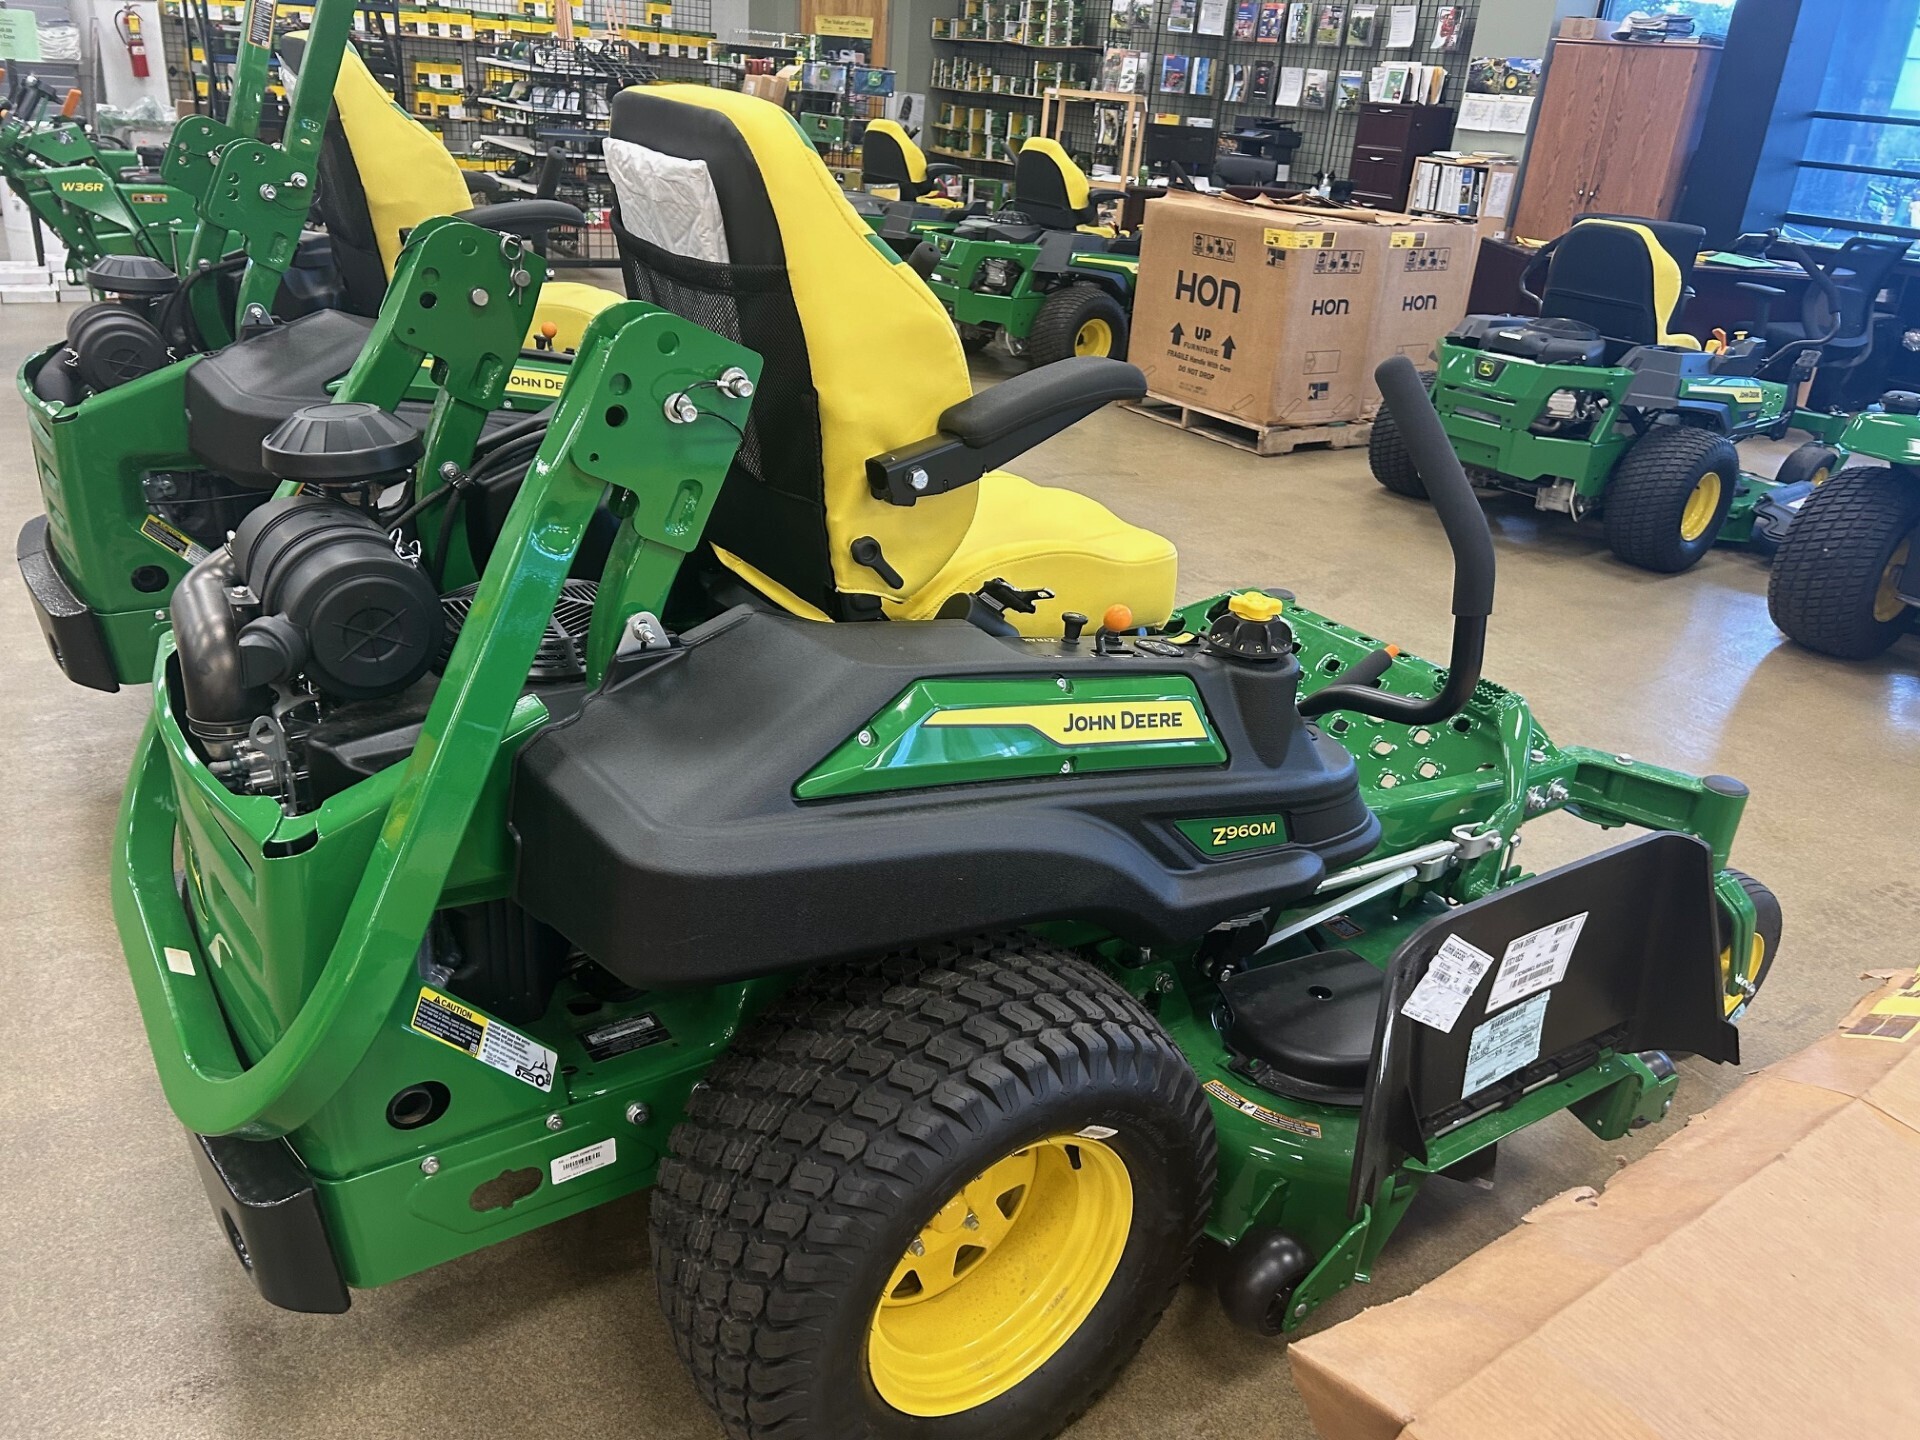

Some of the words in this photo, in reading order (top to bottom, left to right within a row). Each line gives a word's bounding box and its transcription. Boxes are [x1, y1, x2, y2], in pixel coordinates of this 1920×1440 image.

[61, 182, 104, 192] W36R
[1175, 270, 1241, 313] HON
[1311, 299, 1349, 315] HON
[1402, 294, 1437, 311] HON
[1195, 326, 1212, 341] UP
[1166, 349, 1189, 361] FRAGILE
[1183, 341, 1219, 357] FURNITURE
[1178, 364, 1187, 372] DO
[1187, 367, 1199, 376] NOT
[1199, 370, 1215, 381] DROP
[509, 376, 541, 388] OHN
[1063, 713, 1115, 732] JOHN
[1121, 711, 1182, 729] DEERE
[1212, 821, 1276, 846] Z960M
[441, 1000, 473, 1020] CAUTION
